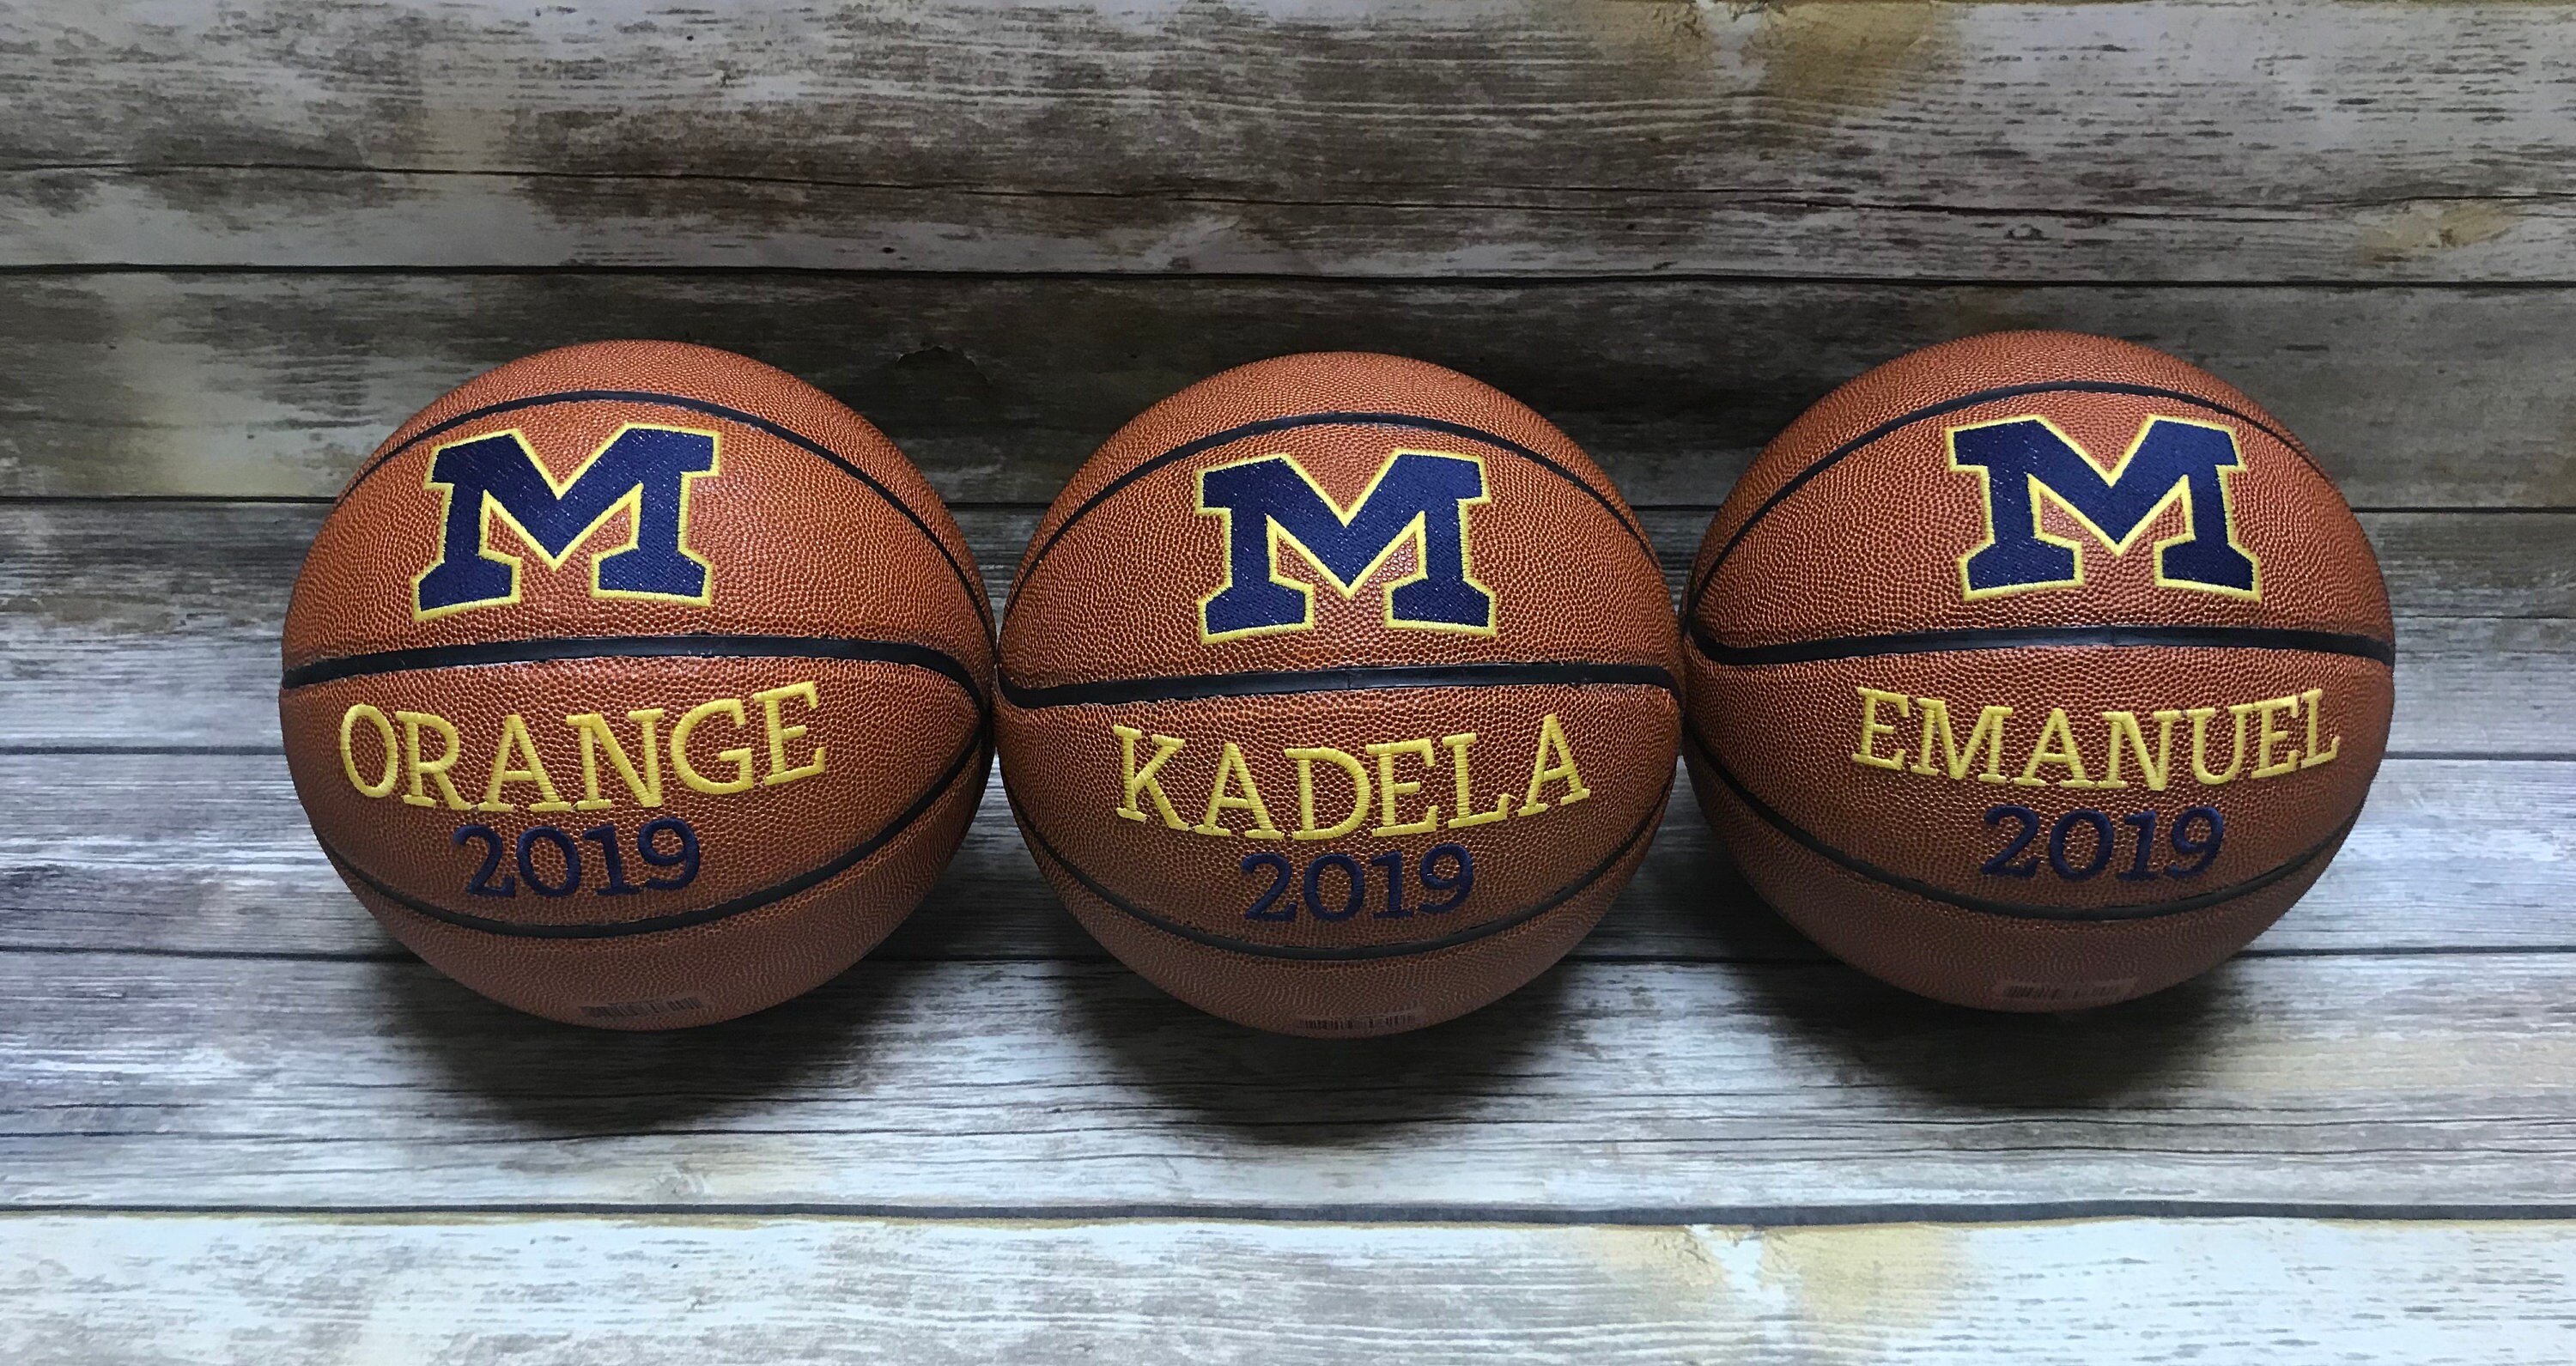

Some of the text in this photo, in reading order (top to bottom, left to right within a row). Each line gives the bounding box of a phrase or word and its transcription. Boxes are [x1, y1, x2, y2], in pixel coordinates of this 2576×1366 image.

[412, 422, 721, 621] M
[1196, 448, 1497, 644] M
[1946, 415, 2261, 600] M
[340, 681, 825, 811] ORANGE
[1114, 713, 1590, 840] KADELA
[1851, 687, 2339, 791] EMANUEL
[453, 817, 701, 897] 2019
[1241, 844, 1475, 922] 2019
[1980, 806, 2223, 881] 2019
